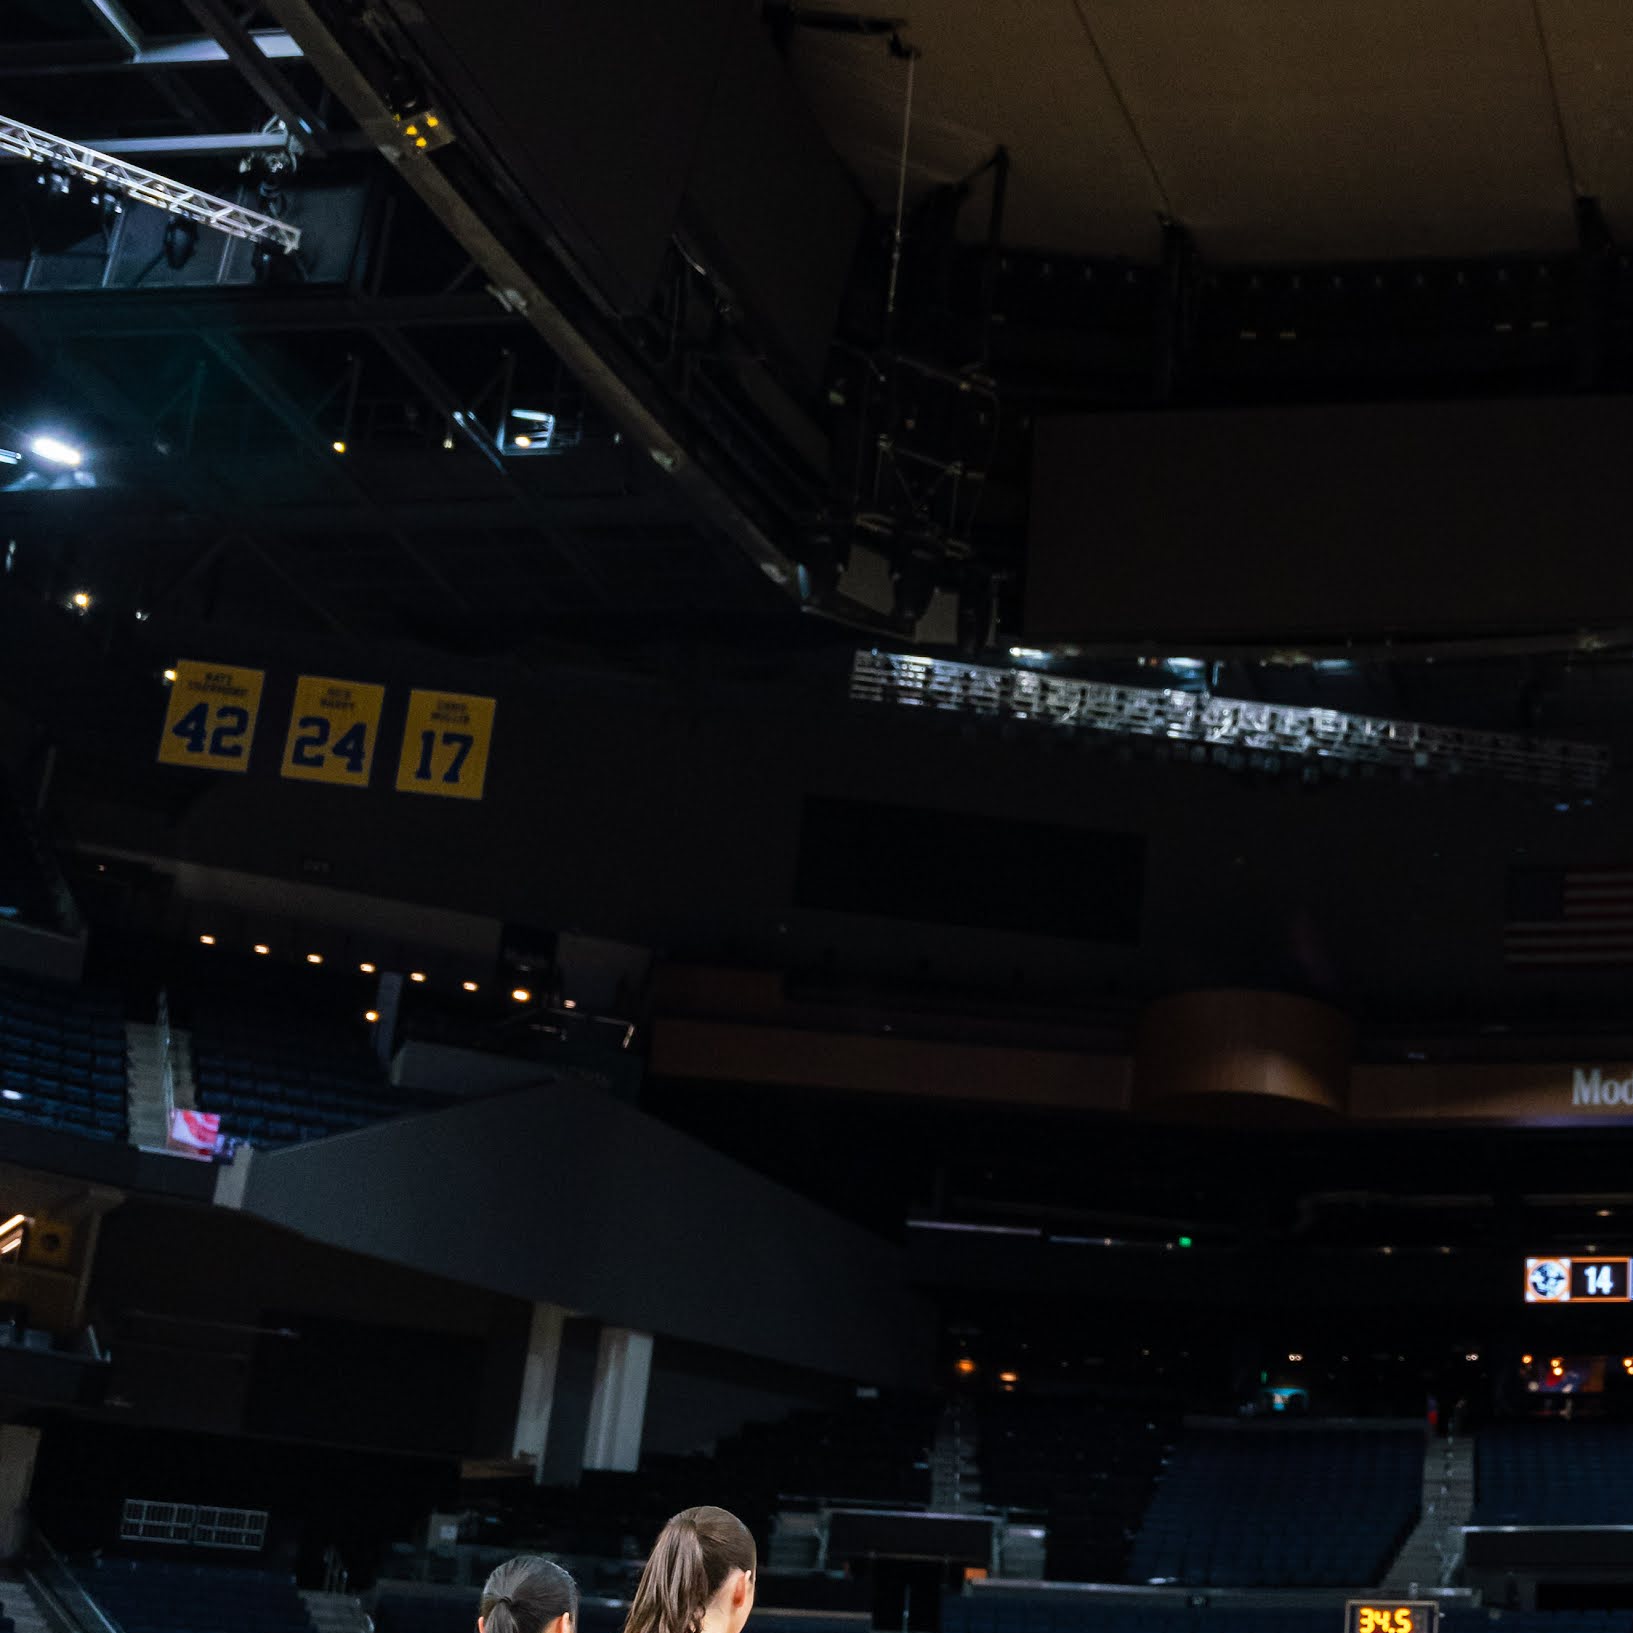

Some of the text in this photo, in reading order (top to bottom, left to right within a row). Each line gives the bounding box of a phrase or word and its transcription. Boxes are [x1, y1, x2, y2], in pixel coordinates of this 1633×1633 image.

[172, 703, 249, 758] 42
[292, 717, 368, 773] 24
[415, 731, 474, 783] 17
[1584, 1266, 1613, 1296] 14
